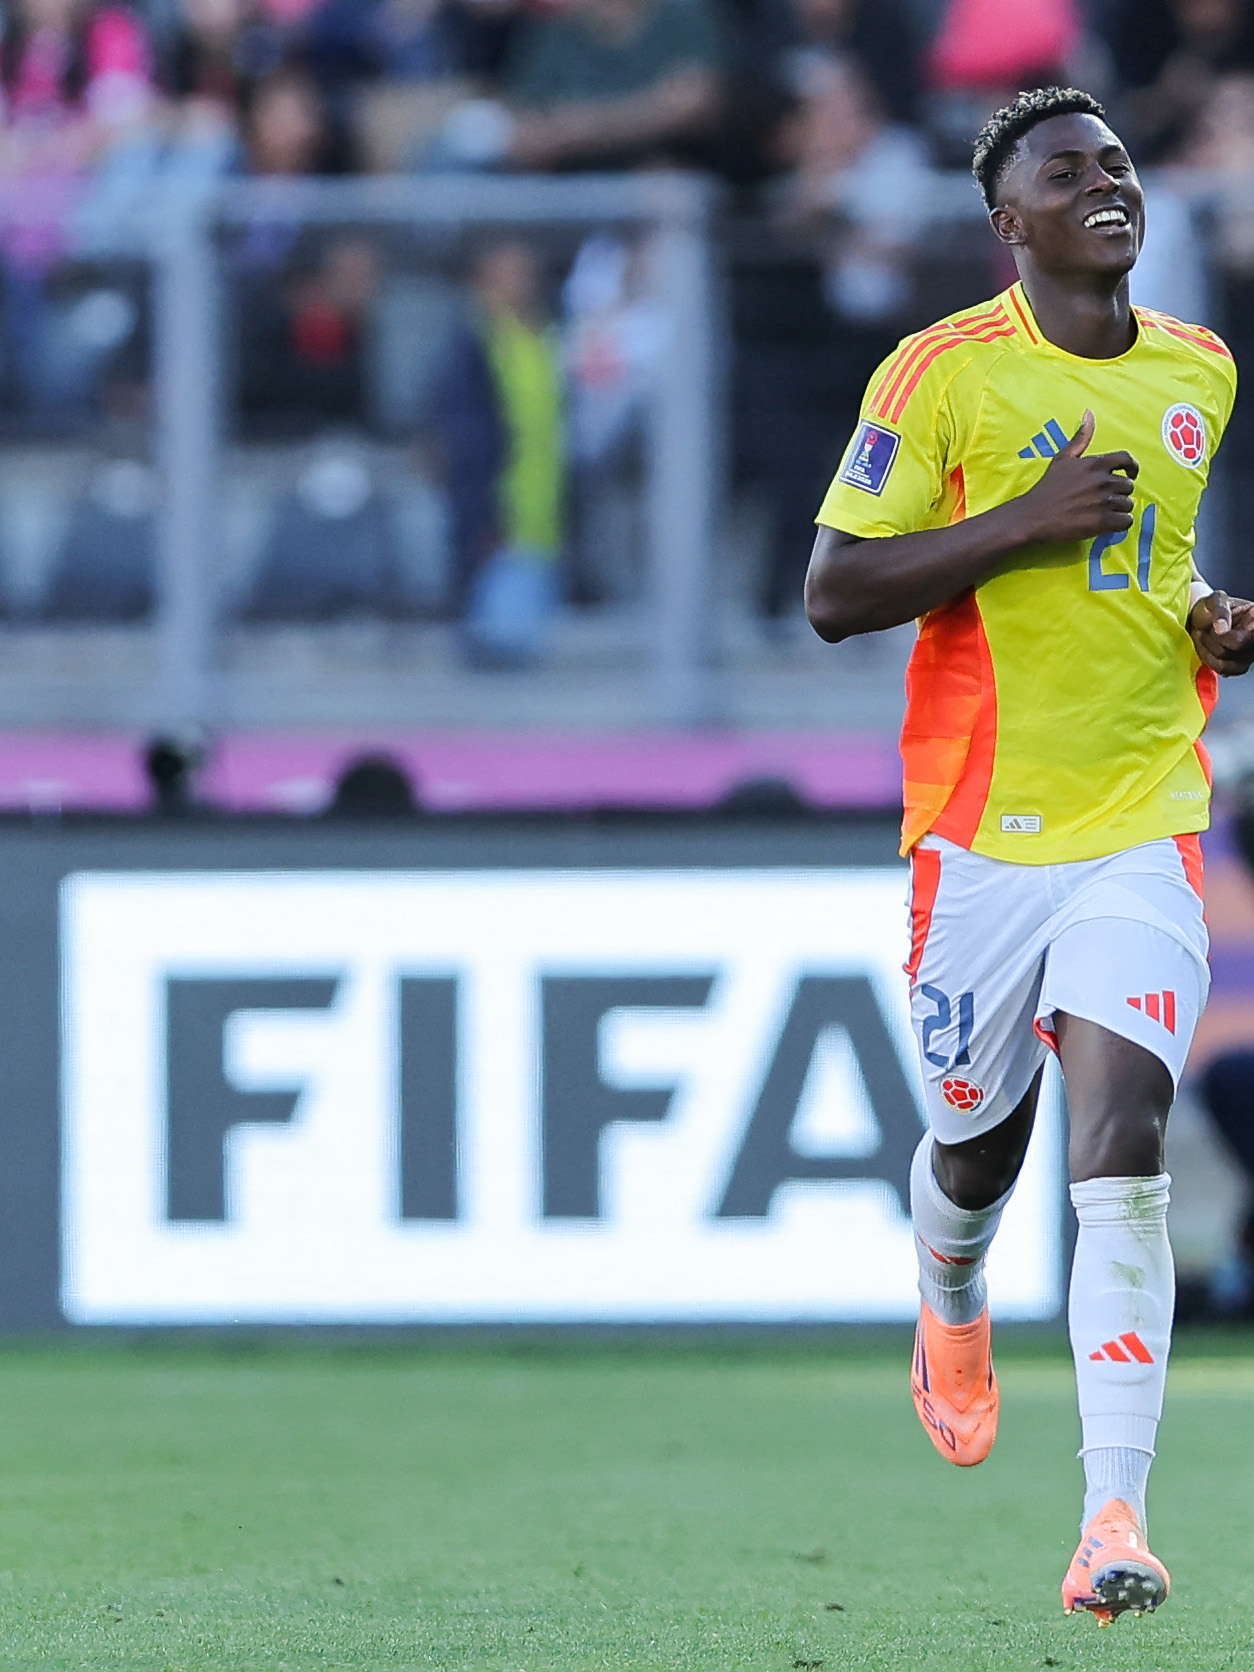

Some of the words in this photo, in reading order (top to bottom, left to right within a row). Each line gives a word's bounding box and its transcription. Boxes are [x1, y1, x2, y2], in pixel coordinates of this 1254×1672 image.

[1089, 503, 1156, 592] 21
[921, 983, 974, 1070] 21
[164, 975, 925, 1221] FIFA
